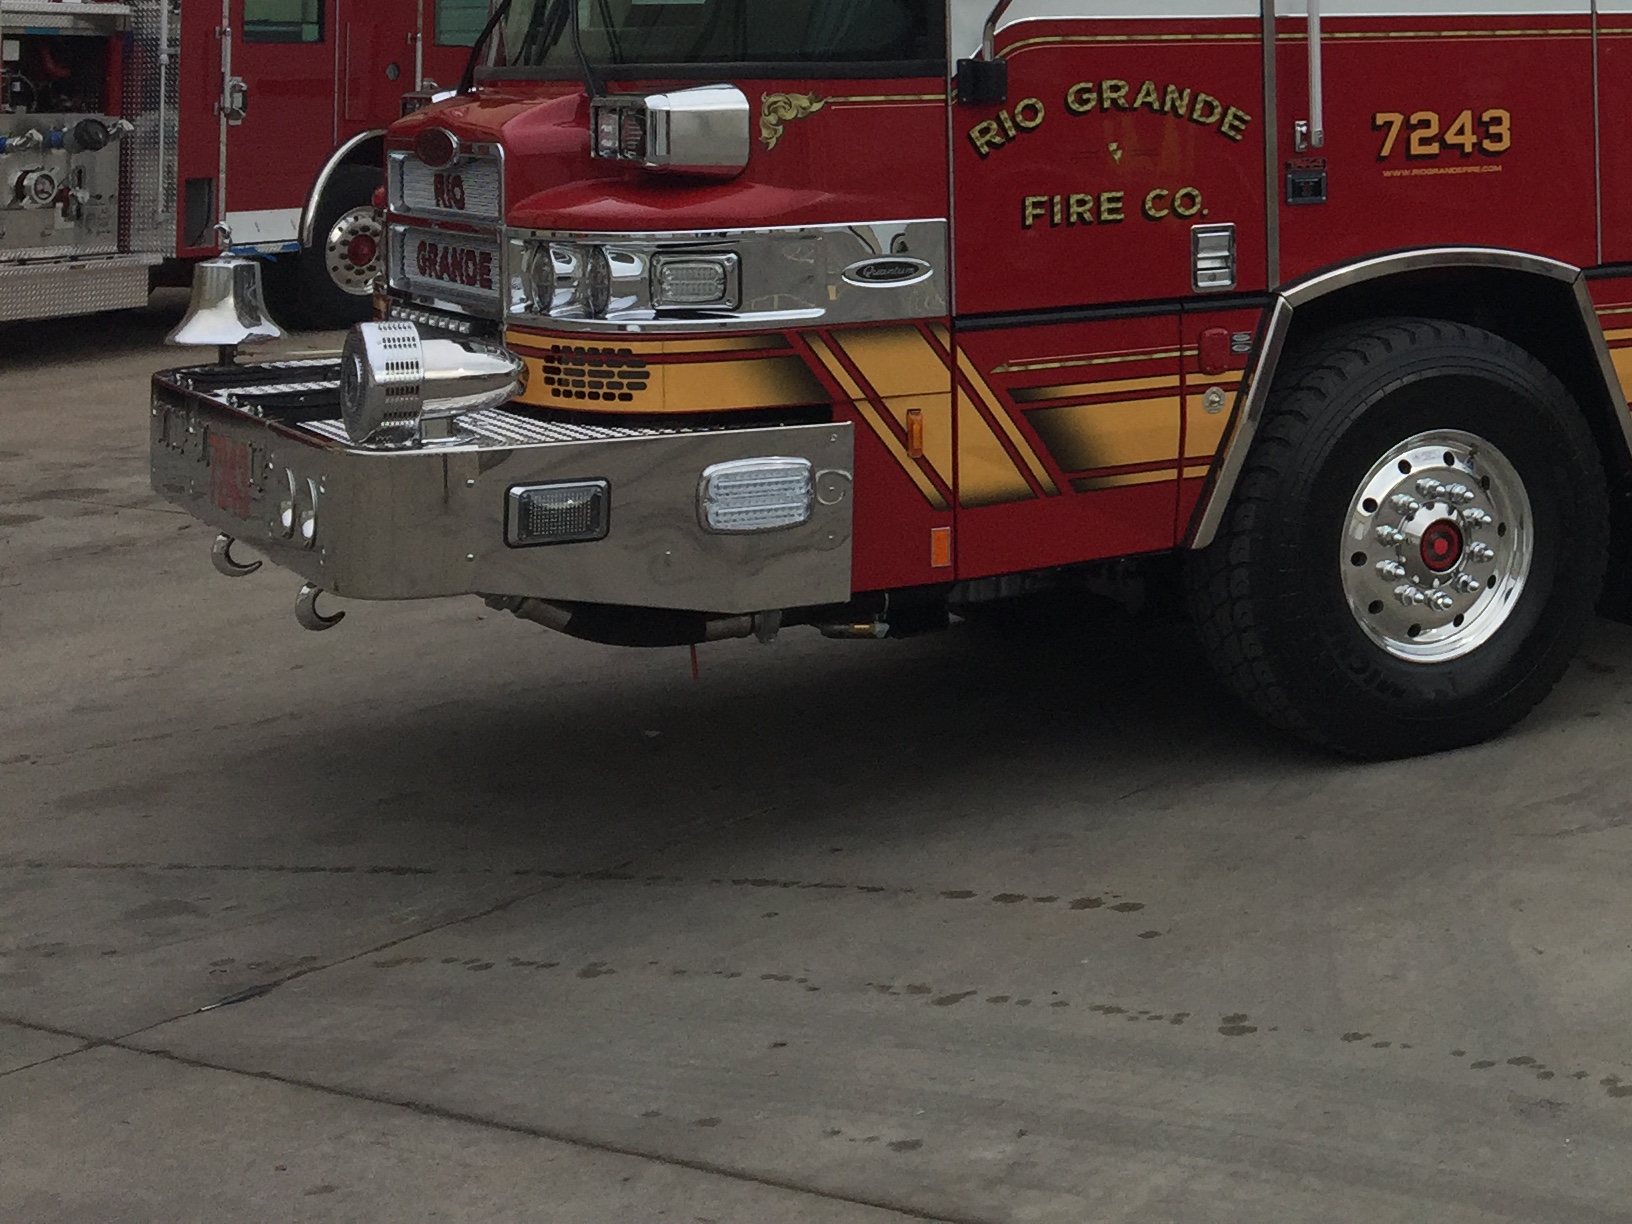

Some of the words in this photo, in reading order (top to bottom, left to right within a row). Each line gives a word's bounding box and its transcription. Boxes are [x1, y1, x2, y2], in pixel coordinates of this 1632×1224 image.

[968, 97, 1045, 157] RIO
[1064, 79, 1251, 142] GRANDE
[1373, 108, 1512, 162] 7243
[433, 173, 466, 210] RIO
[1022, 190, 1126, 229] FIRE
[1142, 186, 1210, 219] CO.
[416, 240, 493, 290] GRANDE
[862, 265, 917, 278] Quantum
